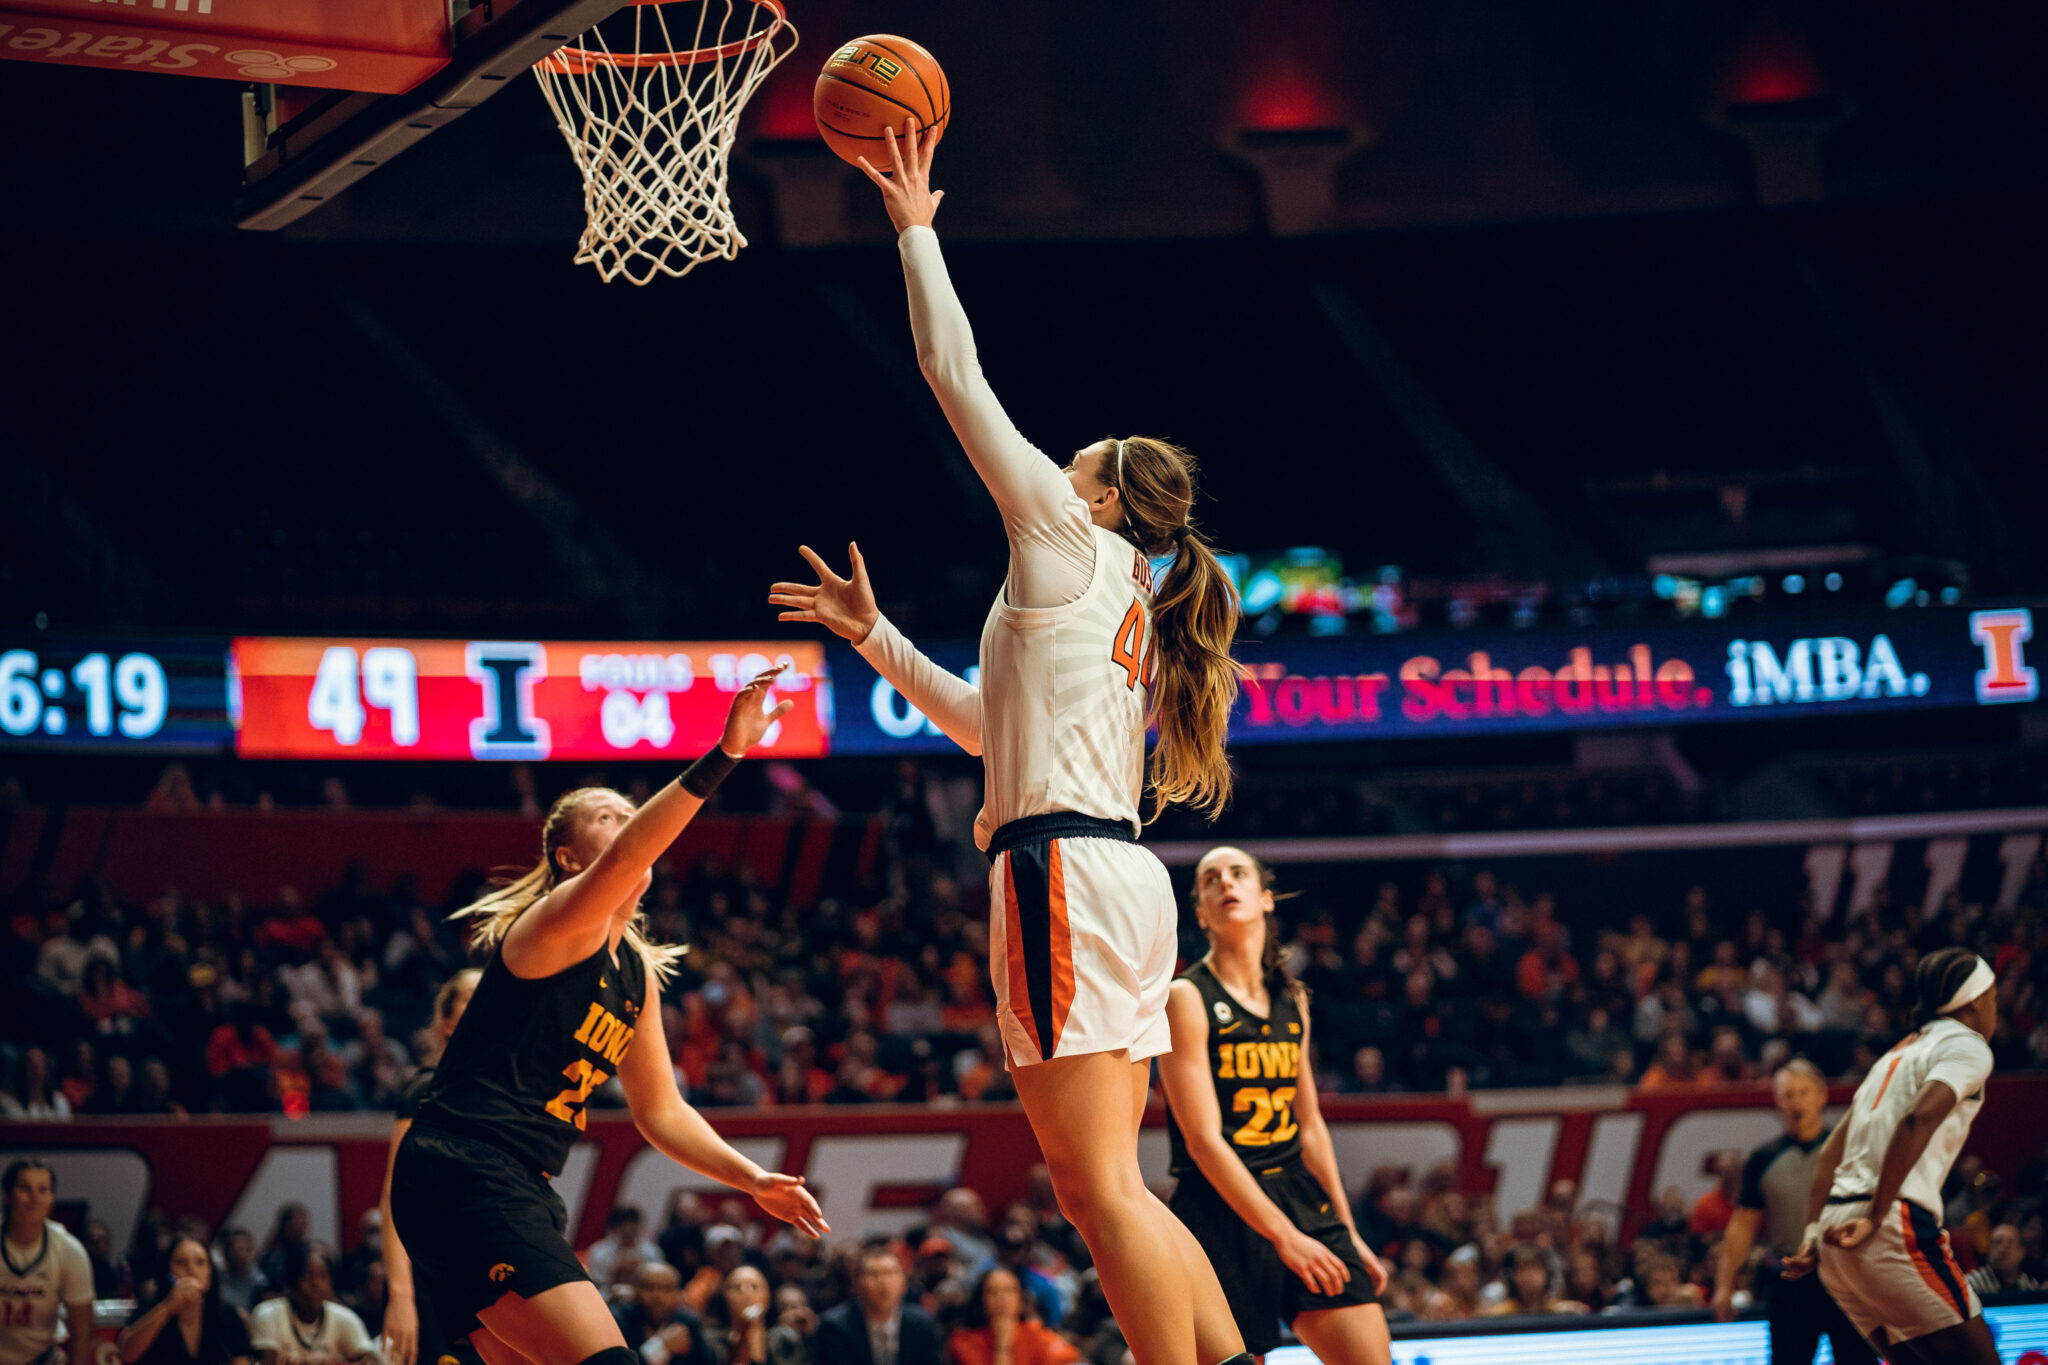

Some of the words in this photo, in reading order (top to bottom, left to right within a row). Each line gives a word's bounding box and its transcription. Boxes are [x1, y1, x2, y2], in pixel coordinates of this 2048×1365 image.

[8, 28, 221, 69] State
[834, 46, 902, 83] ELITE
[0, 649, 169, 739] 6:19
[308, 646, 420, 746] 49
[1239, 662, 1389, 727] Your
[1400, 643, 1713, 722] Schedule.
[1725, 634, 1931, 707] iMBA.
[601, 688, 676, 749] 04
[573, 1001, 635, 1067] IOW
